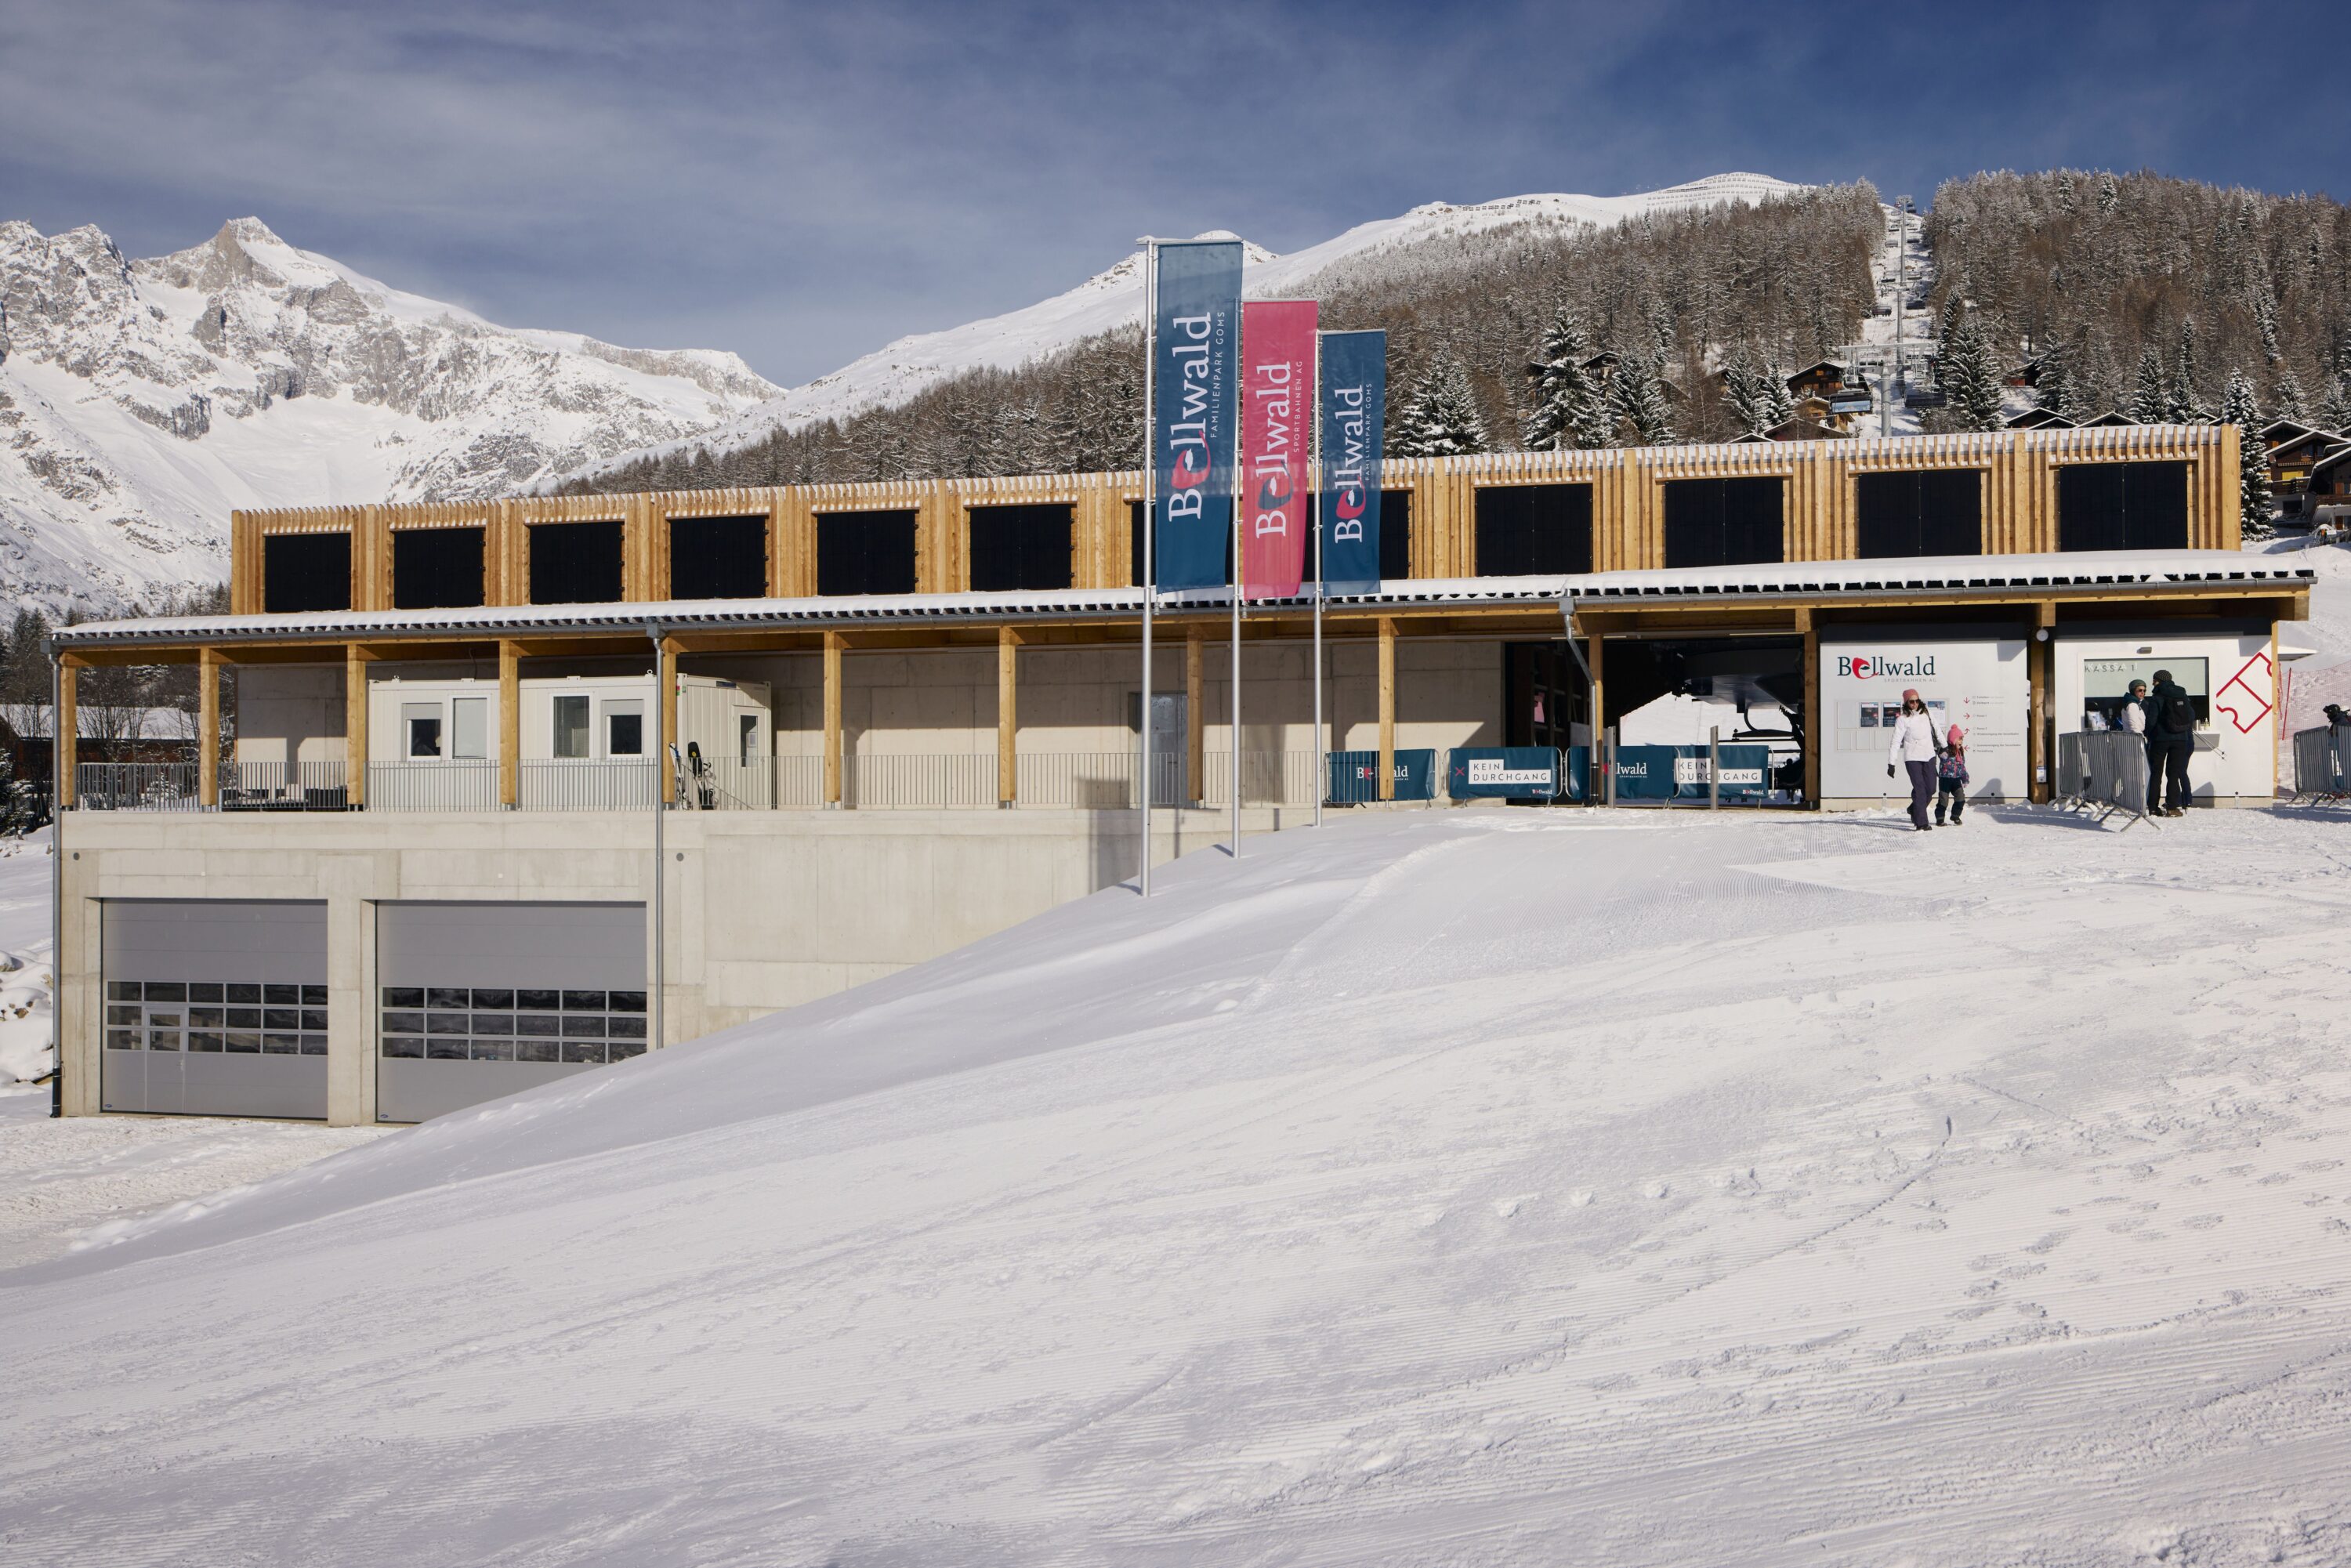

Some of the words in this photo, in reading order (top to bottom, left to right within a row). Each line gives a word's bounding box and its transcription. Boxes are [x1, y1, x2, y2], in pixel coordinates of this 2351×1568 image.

[1215, 311, 1226, 345] GOMS
[1295, 360, 1303, 374] AG
[1209, 350, 1223, 438] FAMILIENPARK
[1168, 312, 1212, 522] Bellwald
[1292, 377, 1303, 453] SPORTBAHNEN
[1255, 360, 1293, 538] Bellwald
[1334, 384, 1367, 544] Bellwald
[1837, 655, 1936, 679] Bellwald
[2085, 663, 2126, 672] KASSA
[1473, 773, 1547, 781] DURCHGANG
[1679, 772, 1758, 780] DURCGANG
